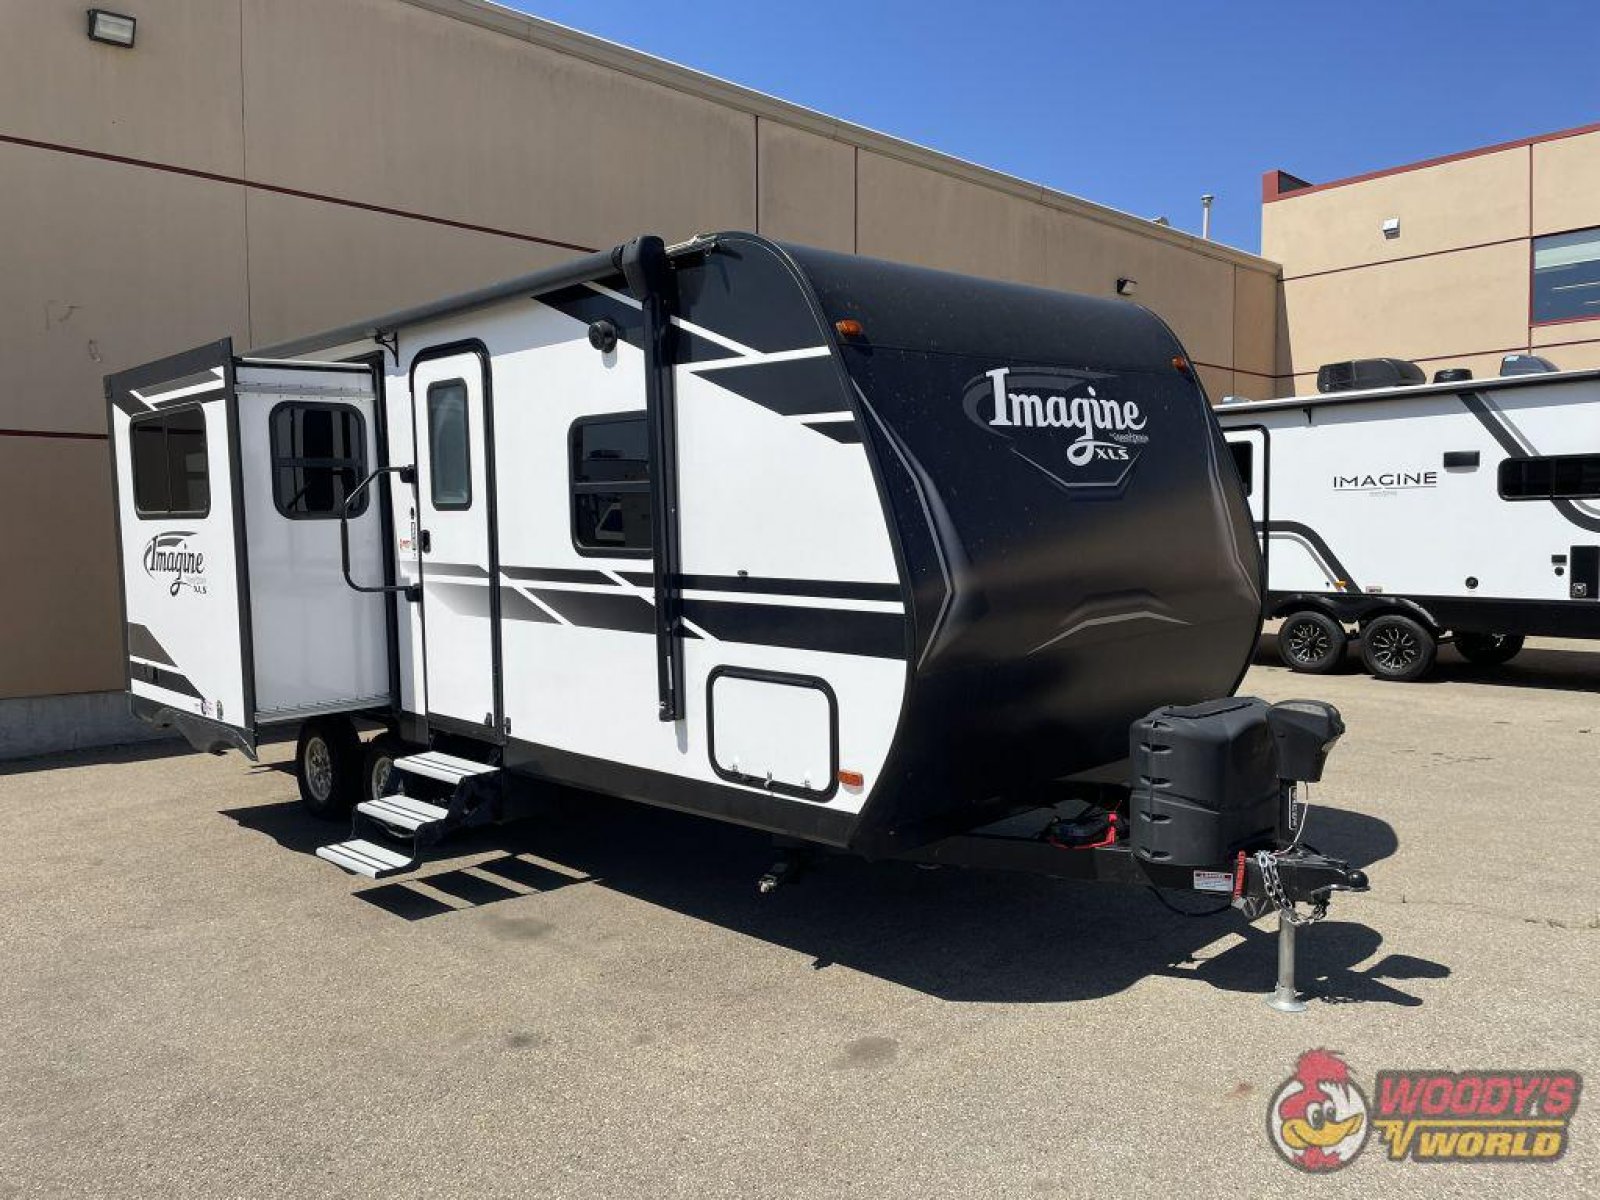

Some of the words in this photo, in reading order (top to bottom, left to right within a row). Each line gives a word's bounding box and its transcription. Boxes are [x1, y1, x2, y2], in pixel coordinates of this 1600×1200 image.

[985, 366, 1148, 467] Imagine
[1094, 448, 1130, 460] XLS
[1333, 471, 1438, 488] IMAGINE
[149, 534, 206, 597] Imagine
